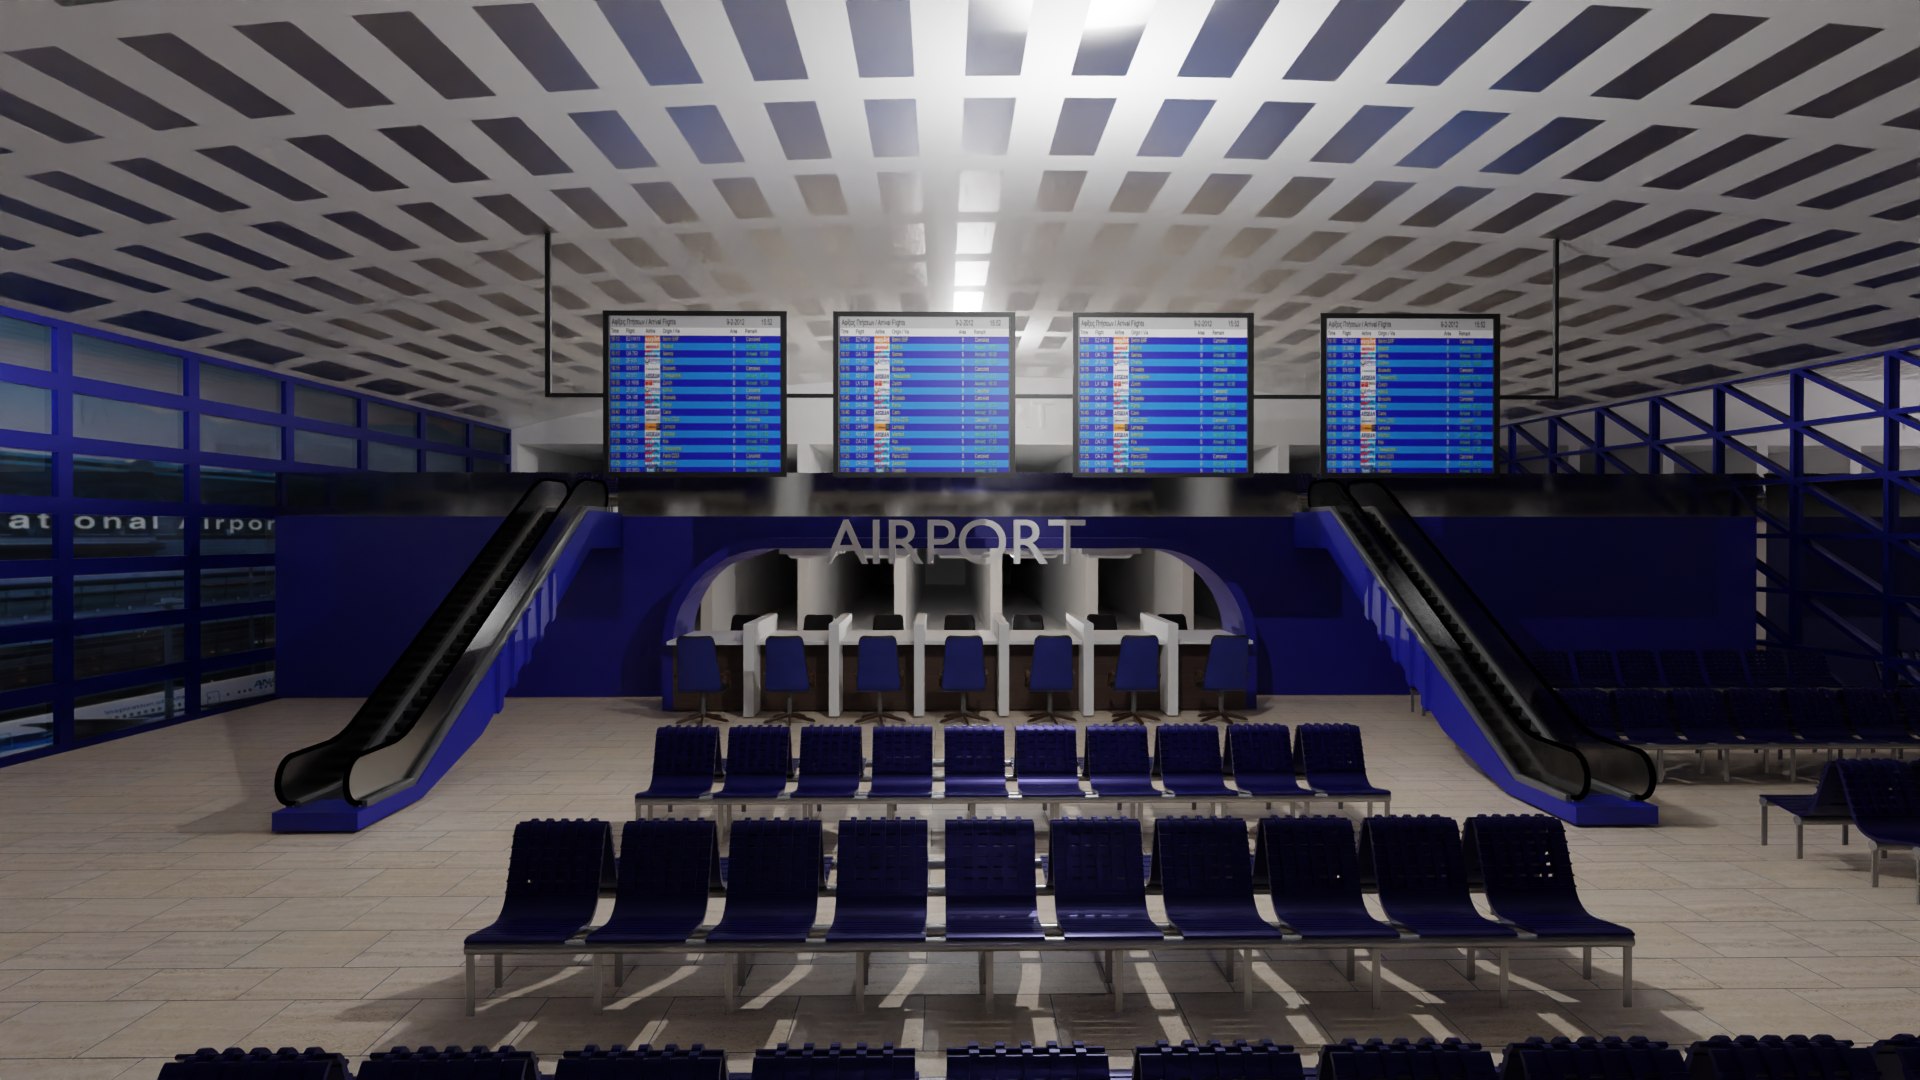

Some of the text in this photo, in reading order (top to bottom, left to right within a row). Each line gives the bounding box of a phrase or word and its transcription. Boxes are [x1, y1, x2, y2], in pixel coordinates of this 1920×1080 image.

[663, 318, 676, 327] Flights
[1131, 320, 1144, 328] Flights
[9, 513, 159, 530] atonal
[829, 518, 1086, 564] AIRPORT
